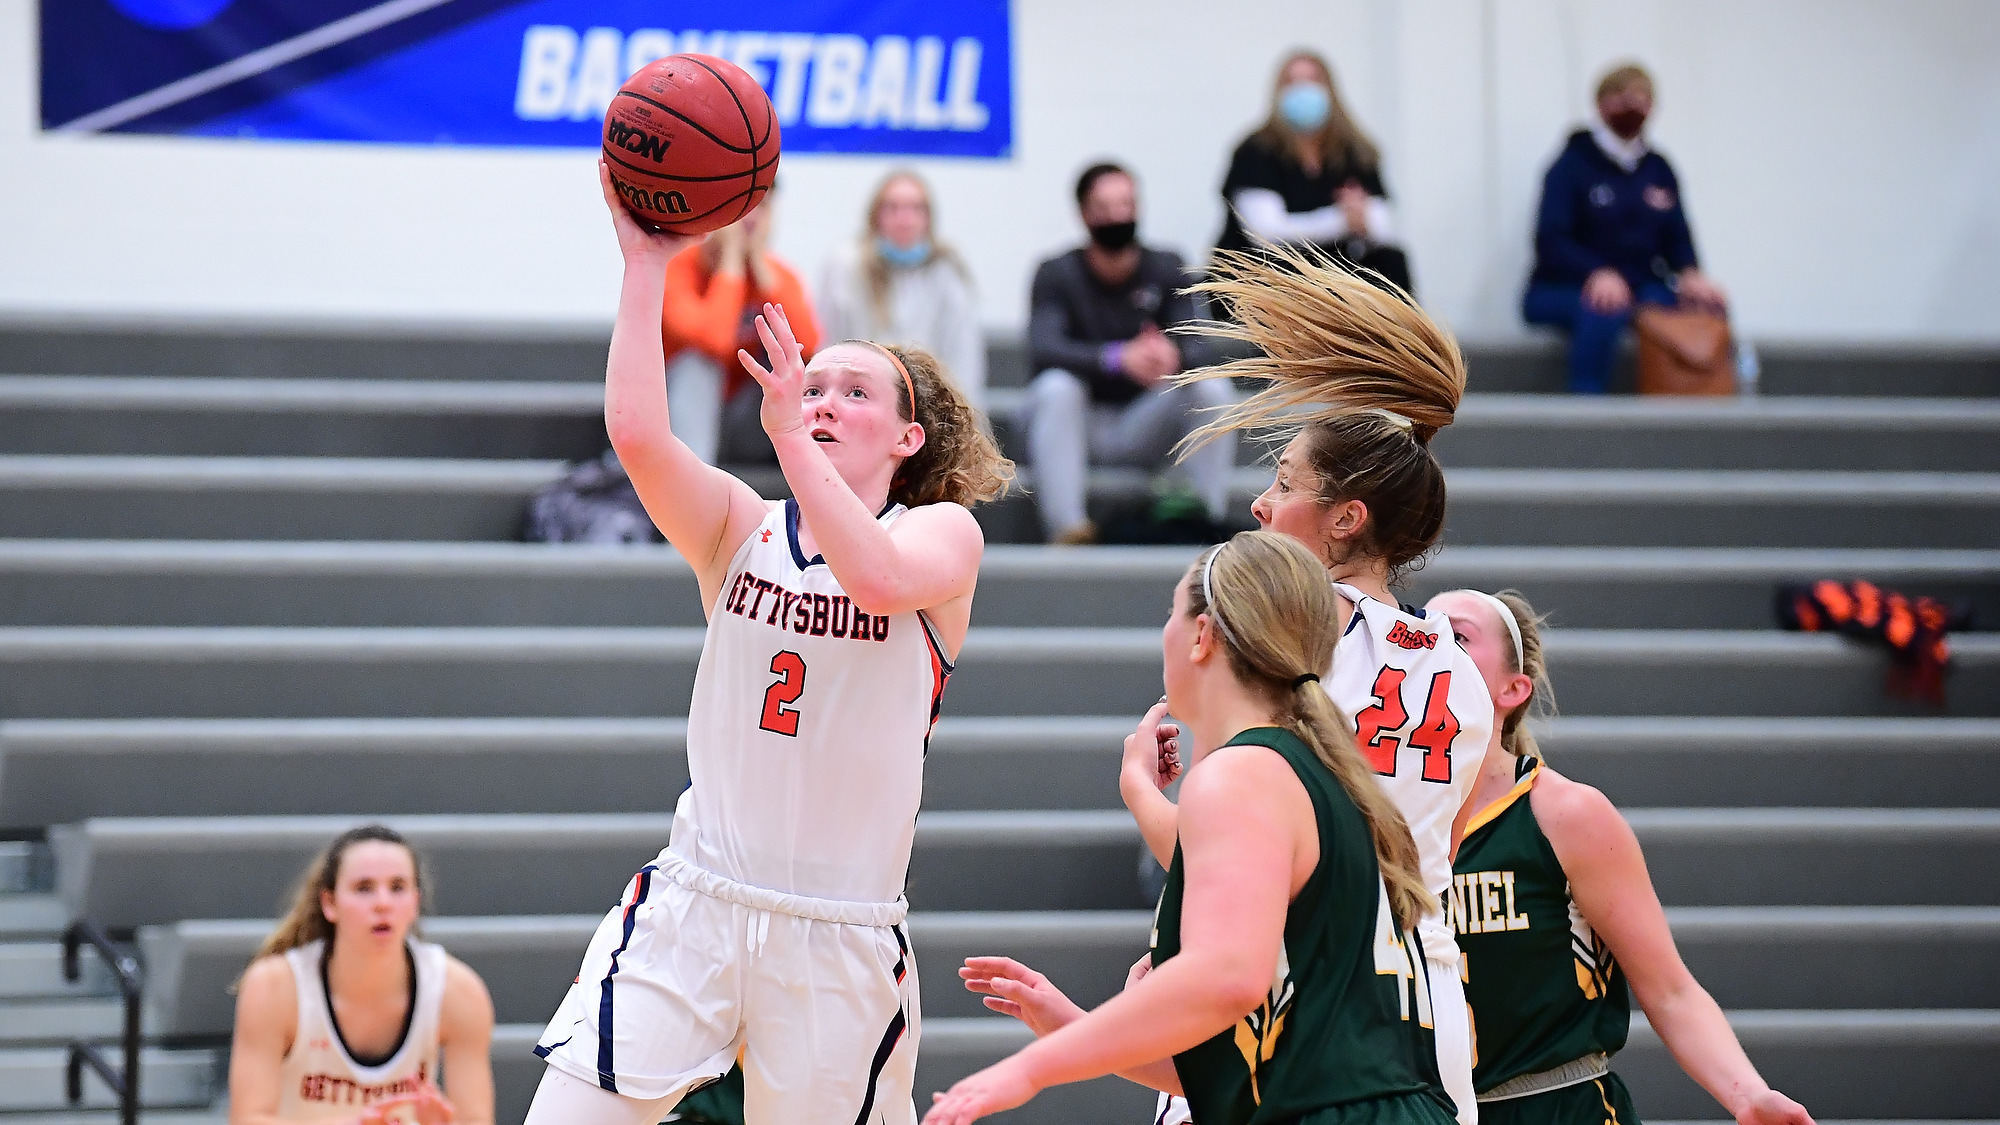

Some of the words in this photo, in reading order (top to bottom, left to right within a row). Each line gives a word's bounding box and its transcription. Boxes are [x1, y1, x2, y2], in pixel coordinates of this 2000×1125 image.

[514, 24, 990, 131] BATBALL
[608, 116, 671, 163] NCAA
[611, 173, 693, 214] Wilso
[759, 649, 807, 737] 2
[1355, 663, 1462, 784] 24
